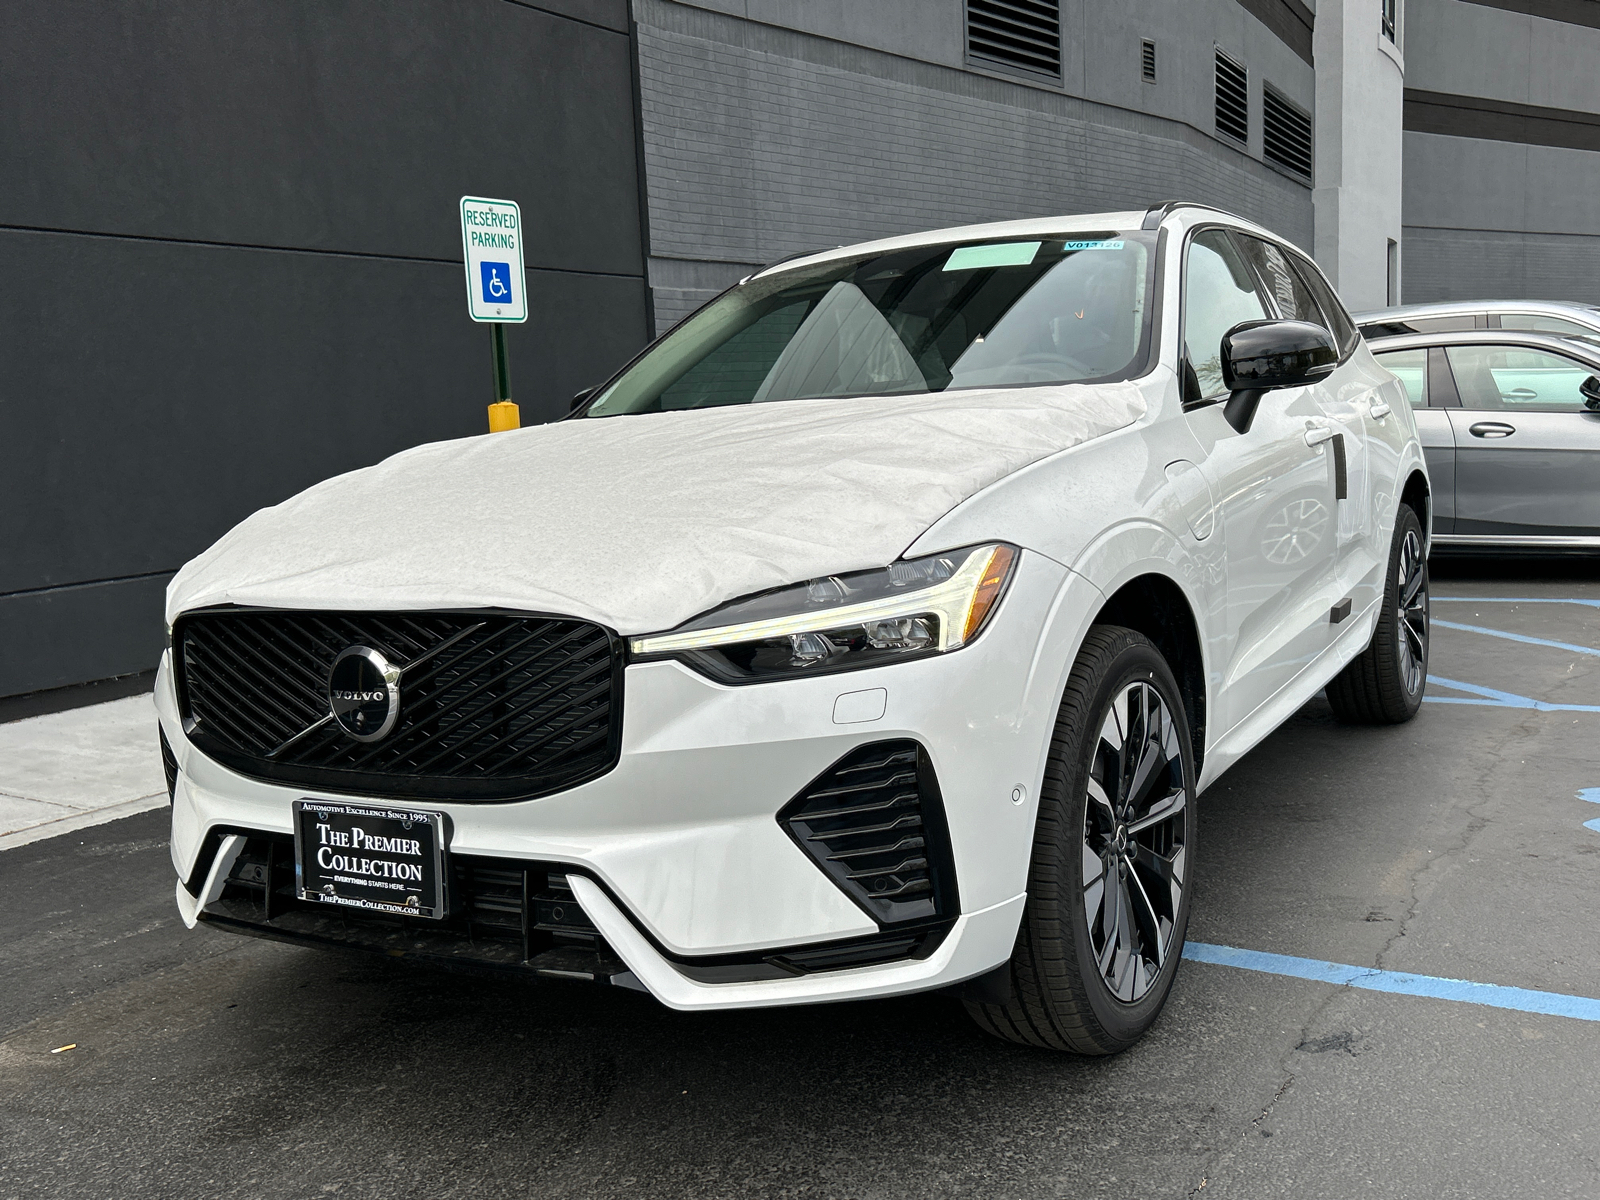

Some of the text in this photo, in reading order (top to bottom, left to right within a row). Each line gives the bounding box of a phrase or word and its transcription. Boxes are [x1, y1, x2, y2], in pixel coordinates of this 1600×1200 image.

[466, 209, 516, 229] RESERVED
[471, 231, 515, 249] PARKING
[333, 689, 384, 702] VOLVO
[409, 813, 428, 823] 1995
[316, 823, 422, 856] THE PREMIER
[317, 847, 422, 882] COLLECTION
[333, 875, 368, 885] EVERYTHING
[367, 880, 389, 889] STARTS
